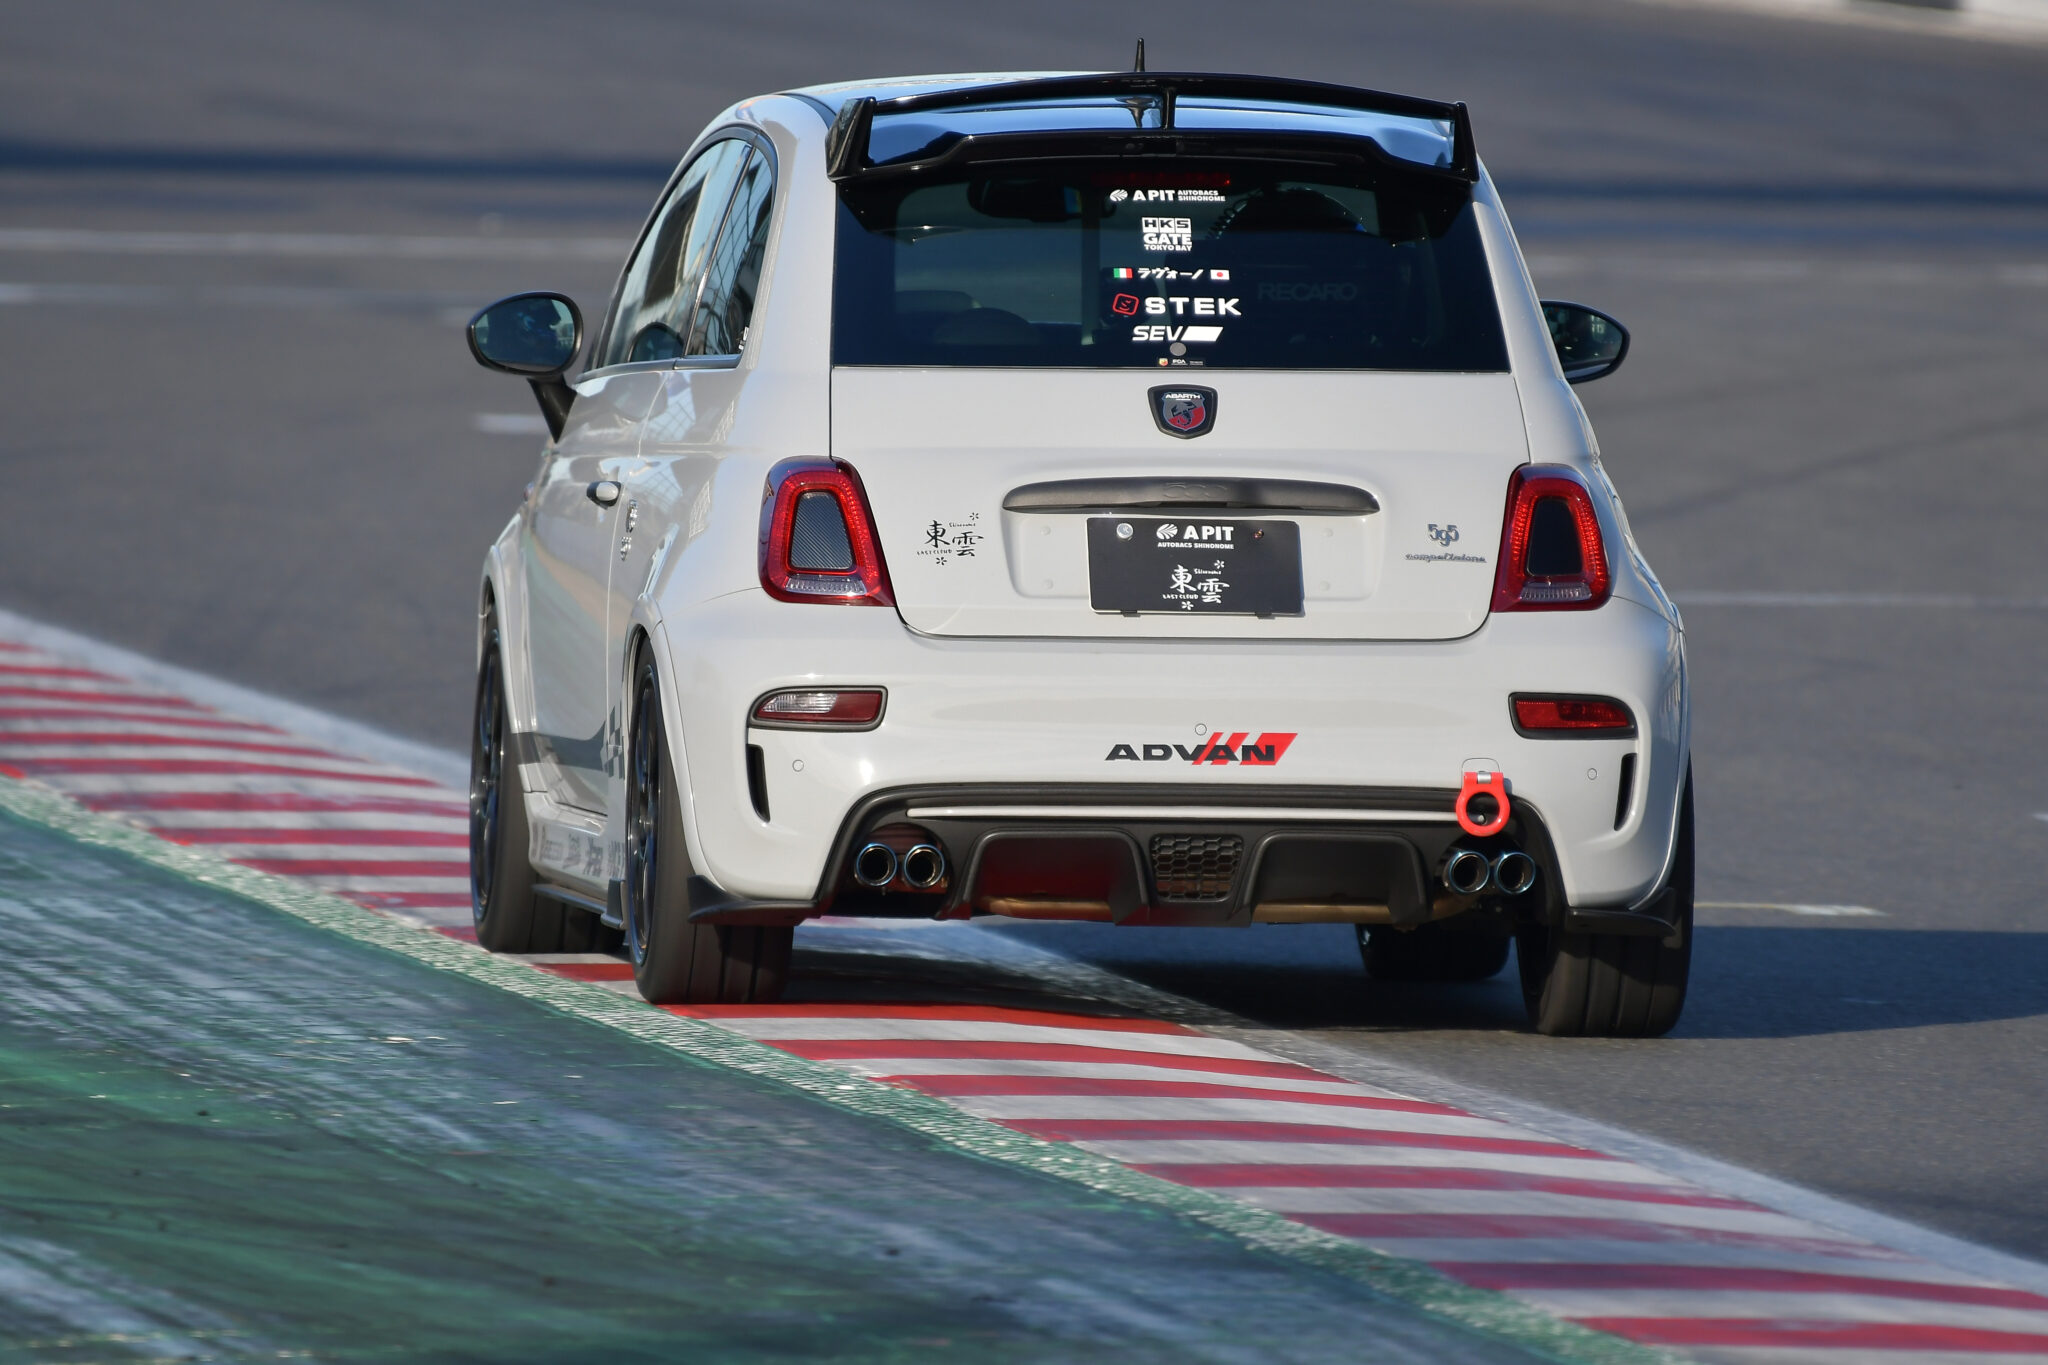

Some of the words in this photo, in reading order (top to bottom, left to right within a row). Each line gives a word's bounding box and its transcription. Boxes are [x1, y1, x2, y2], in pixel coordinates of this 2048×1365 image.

[1142, 218, 1191, 231] HKS
[1143, 233, 1192, 245] GATE
[1257, 283, 1358, 300] RECARO
[1145, 296, 1242, 316] STEK
[1132, 325, 1184, 342] SEV
[1193, 542, 1235, 550] SHINONOME
[1104, 744, 1275, 762] ADVAN
